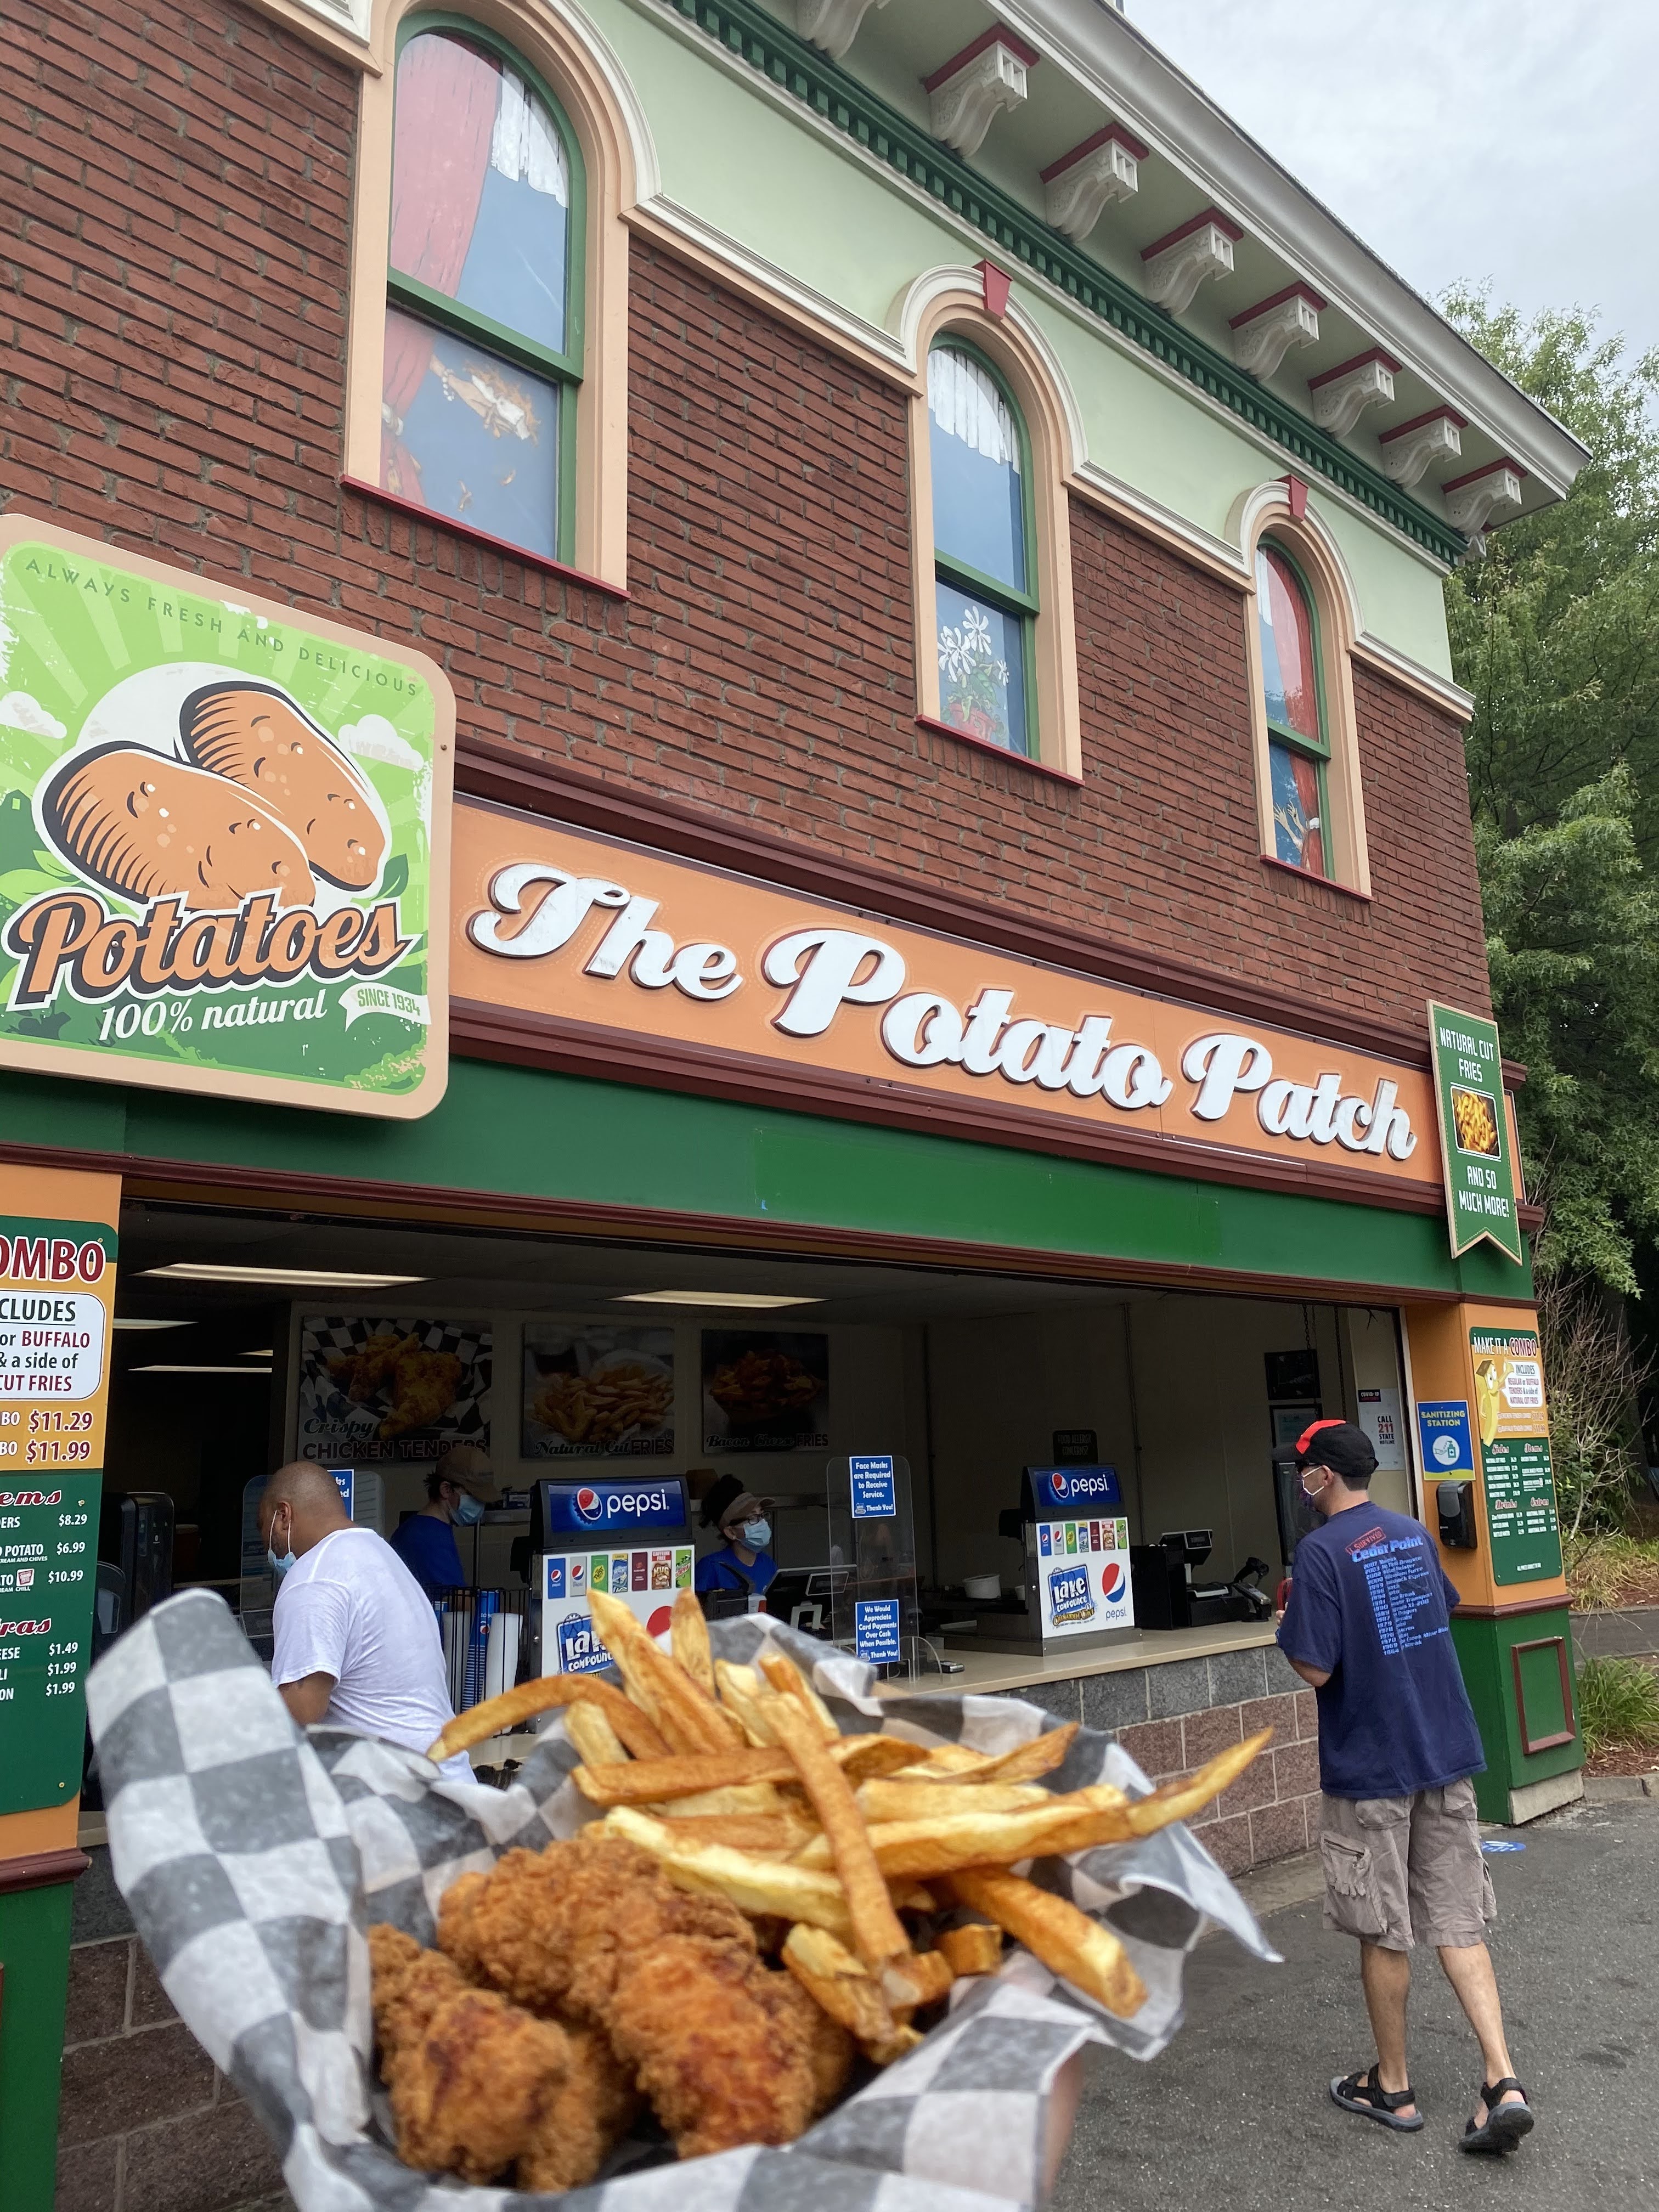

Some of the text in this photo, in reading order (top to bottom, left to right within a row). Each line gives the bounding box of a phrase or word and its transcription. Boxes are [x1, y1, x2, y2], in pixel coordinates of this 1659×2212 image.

[25, 558, 417, 697] ALWAYS FRESH AND DELICIOUS
[9, 891, 413, 1005] Potatoes
[357, 989, 420, 1016] SINCE 1934
[99, 989, 328, 1041] 100% natural
[467, 862, 1418, 1162] The Potato Patch
[1440, 1027, 1494, 1062] NATURAL CUT
[1458, 1058, 1483, 1083] FRIES
[1467, 1166, 1497, 1190] AND SO
[1459, 1190, 1510, 1218] MUCH MORE!
[0, 1330, 91, 1348] or BUFFALO
[1474, 1336, 1537, 1357] MAKE IT A COMBO
[11, 1357, 20, 1368] a
[25, 1352, 58, 1368] side
[62, 1353, 79, 1369] of
[1516, 1364, 1535, 1374] INCLUDES
[29, 1375, 72, 1392] FRIES
[29, 1409, 93, 1434] $11.29
[1421, 1410, 1465, 1419] SANITIZING
[303, 1418, 375, 1440] Crispy
[1378, 1423, 1393, 1434] 211
[535, 1438, 674, 1455] Natural Cut FRIES
[797, 1433, 829, 1447] FRIES
[26, 1439, 91, 1464] $11.99
[302, 1440, 395, 1460] CHICKEN
[870, 1461, 888, 1469] Masks
[865, 1471, 891, 1480] Required
[1070, 1474, 1108, 1497] pepsi
[607, 1488, 667, 1519] pepsi
[0, 1514, 88, 1528] ERS $8.29
[4, 1544, 44, 1557] POTATO
[57, 1542, 86, 1555] $6.99
[1352, 1543, 1389, 1562] Cedar
[1389, 1536, 1424, 1553] Point
[48, 1570, 83, 1584] $10.99
[864, 1614, 891, 1622] Appreciate
[1106, 1607, 1127, 1621] pepsi
[872, 1622, 897, 1630] Payments
[49, 1641, 78, 1656] $1.49
[875, 1638, 897, 1646] Possible.
[568, 1652, 614, 1672] COMPOUNC
[871, 1650, 886, 1658] Thank
[47, 1662, 77, 1677] $1.99
[46, 1681, 75, 1697] $1.99
